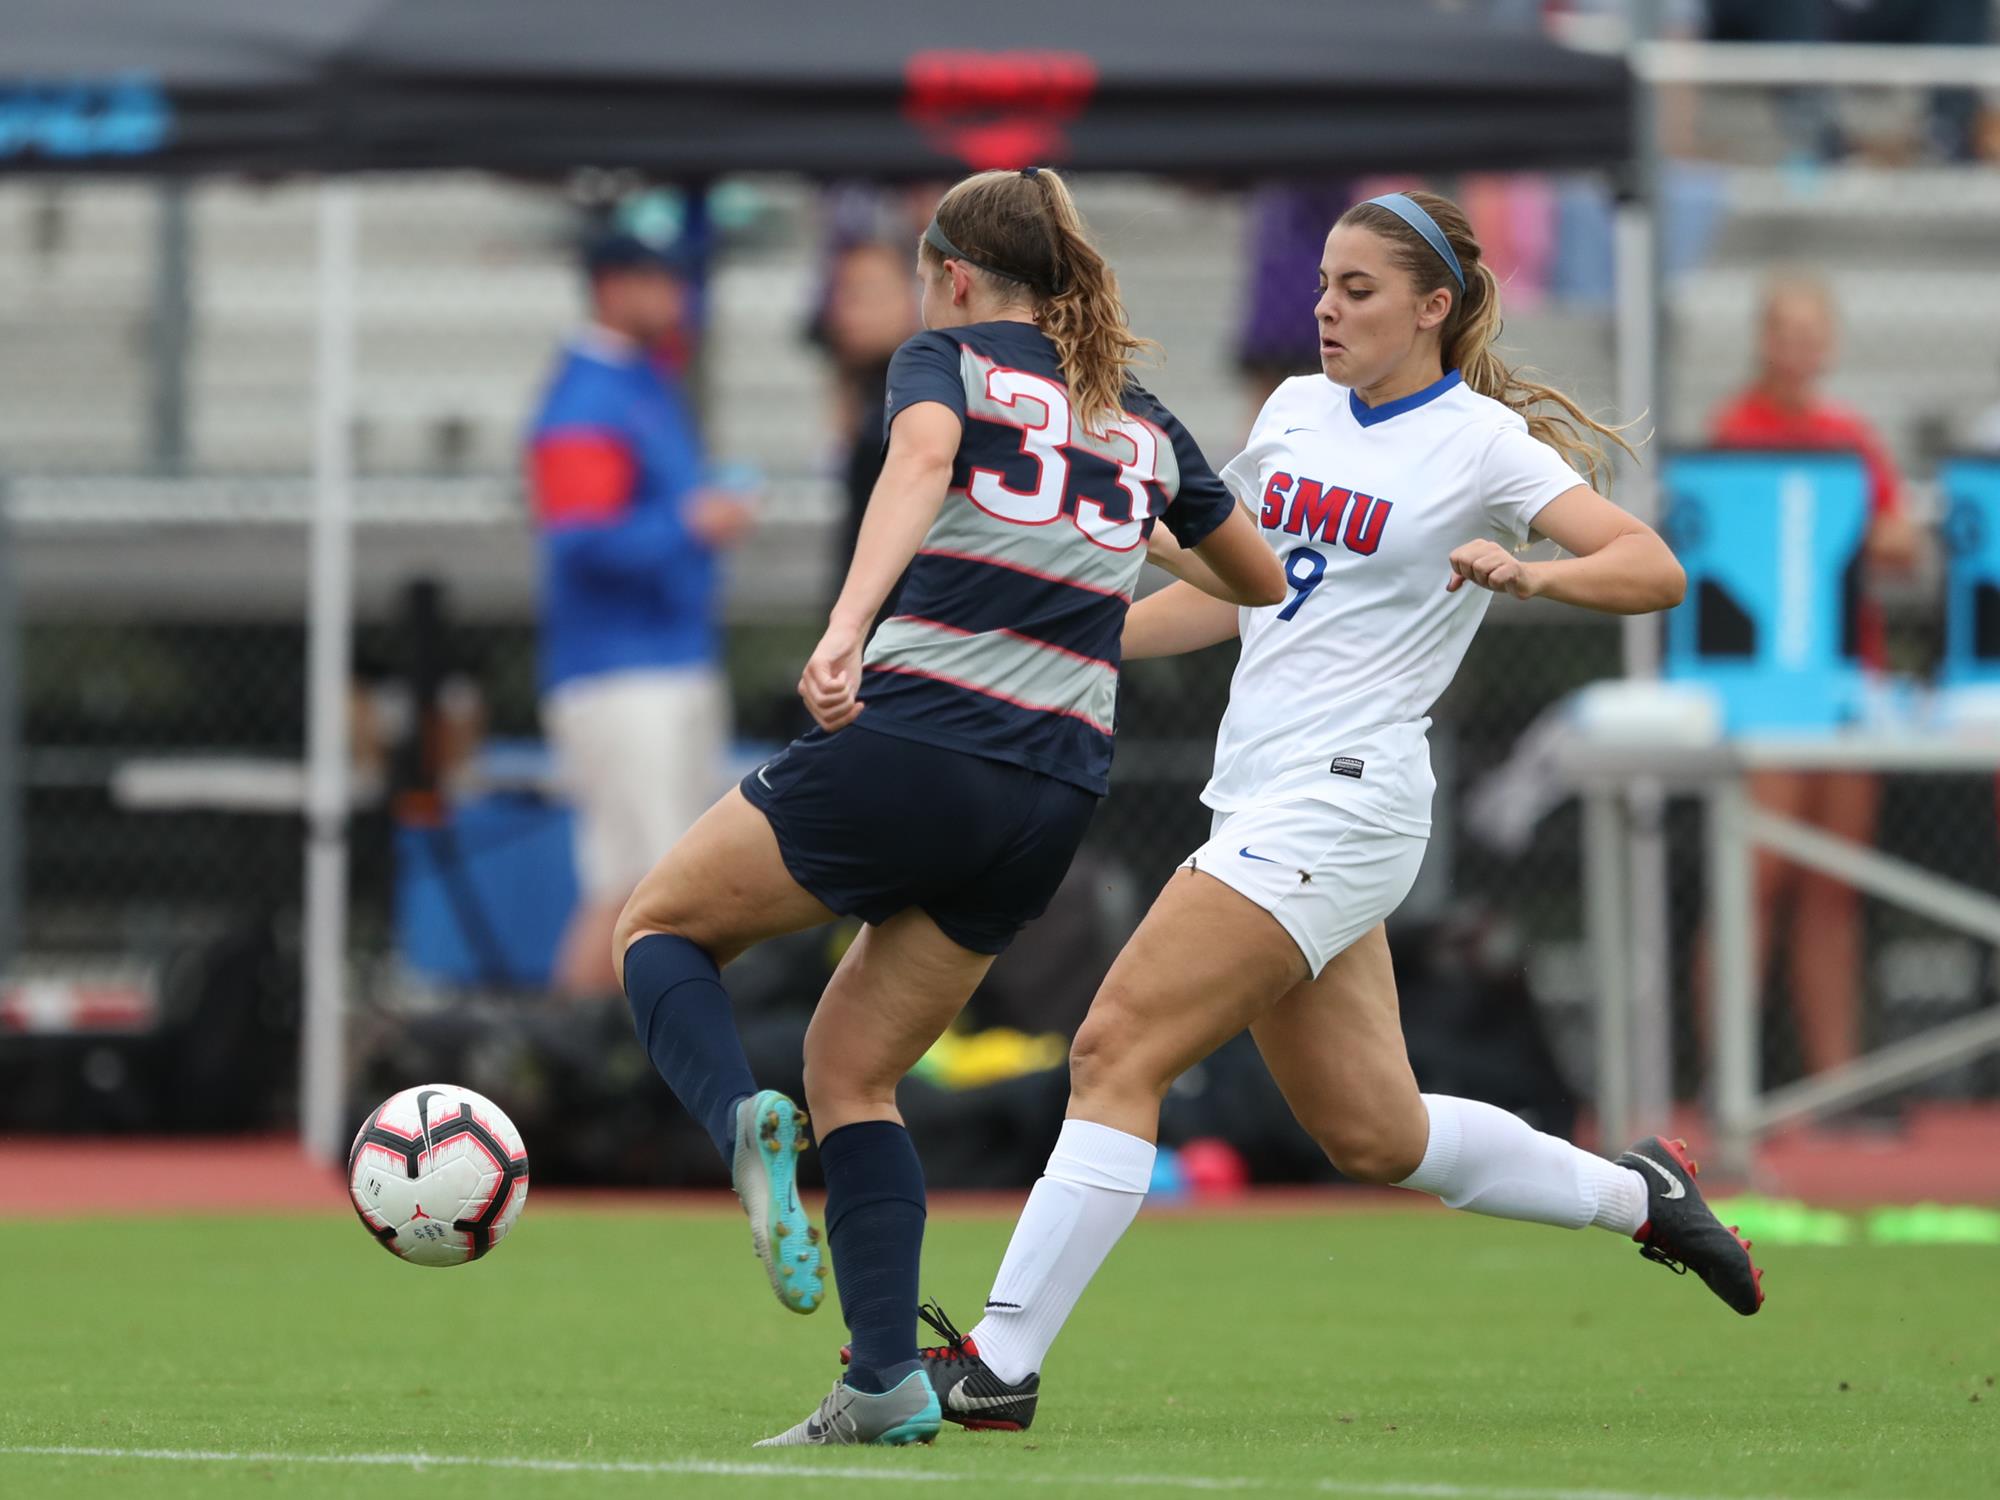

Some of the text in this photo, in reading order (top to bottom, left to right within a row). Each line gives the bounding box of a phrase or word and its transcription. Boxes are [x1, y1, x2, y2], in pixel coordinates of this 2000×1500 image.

[966, 367, 1157, 552] 33
[1260, 471, 1394, 557] SMU
[1276, 546, 1328, 622] 9
